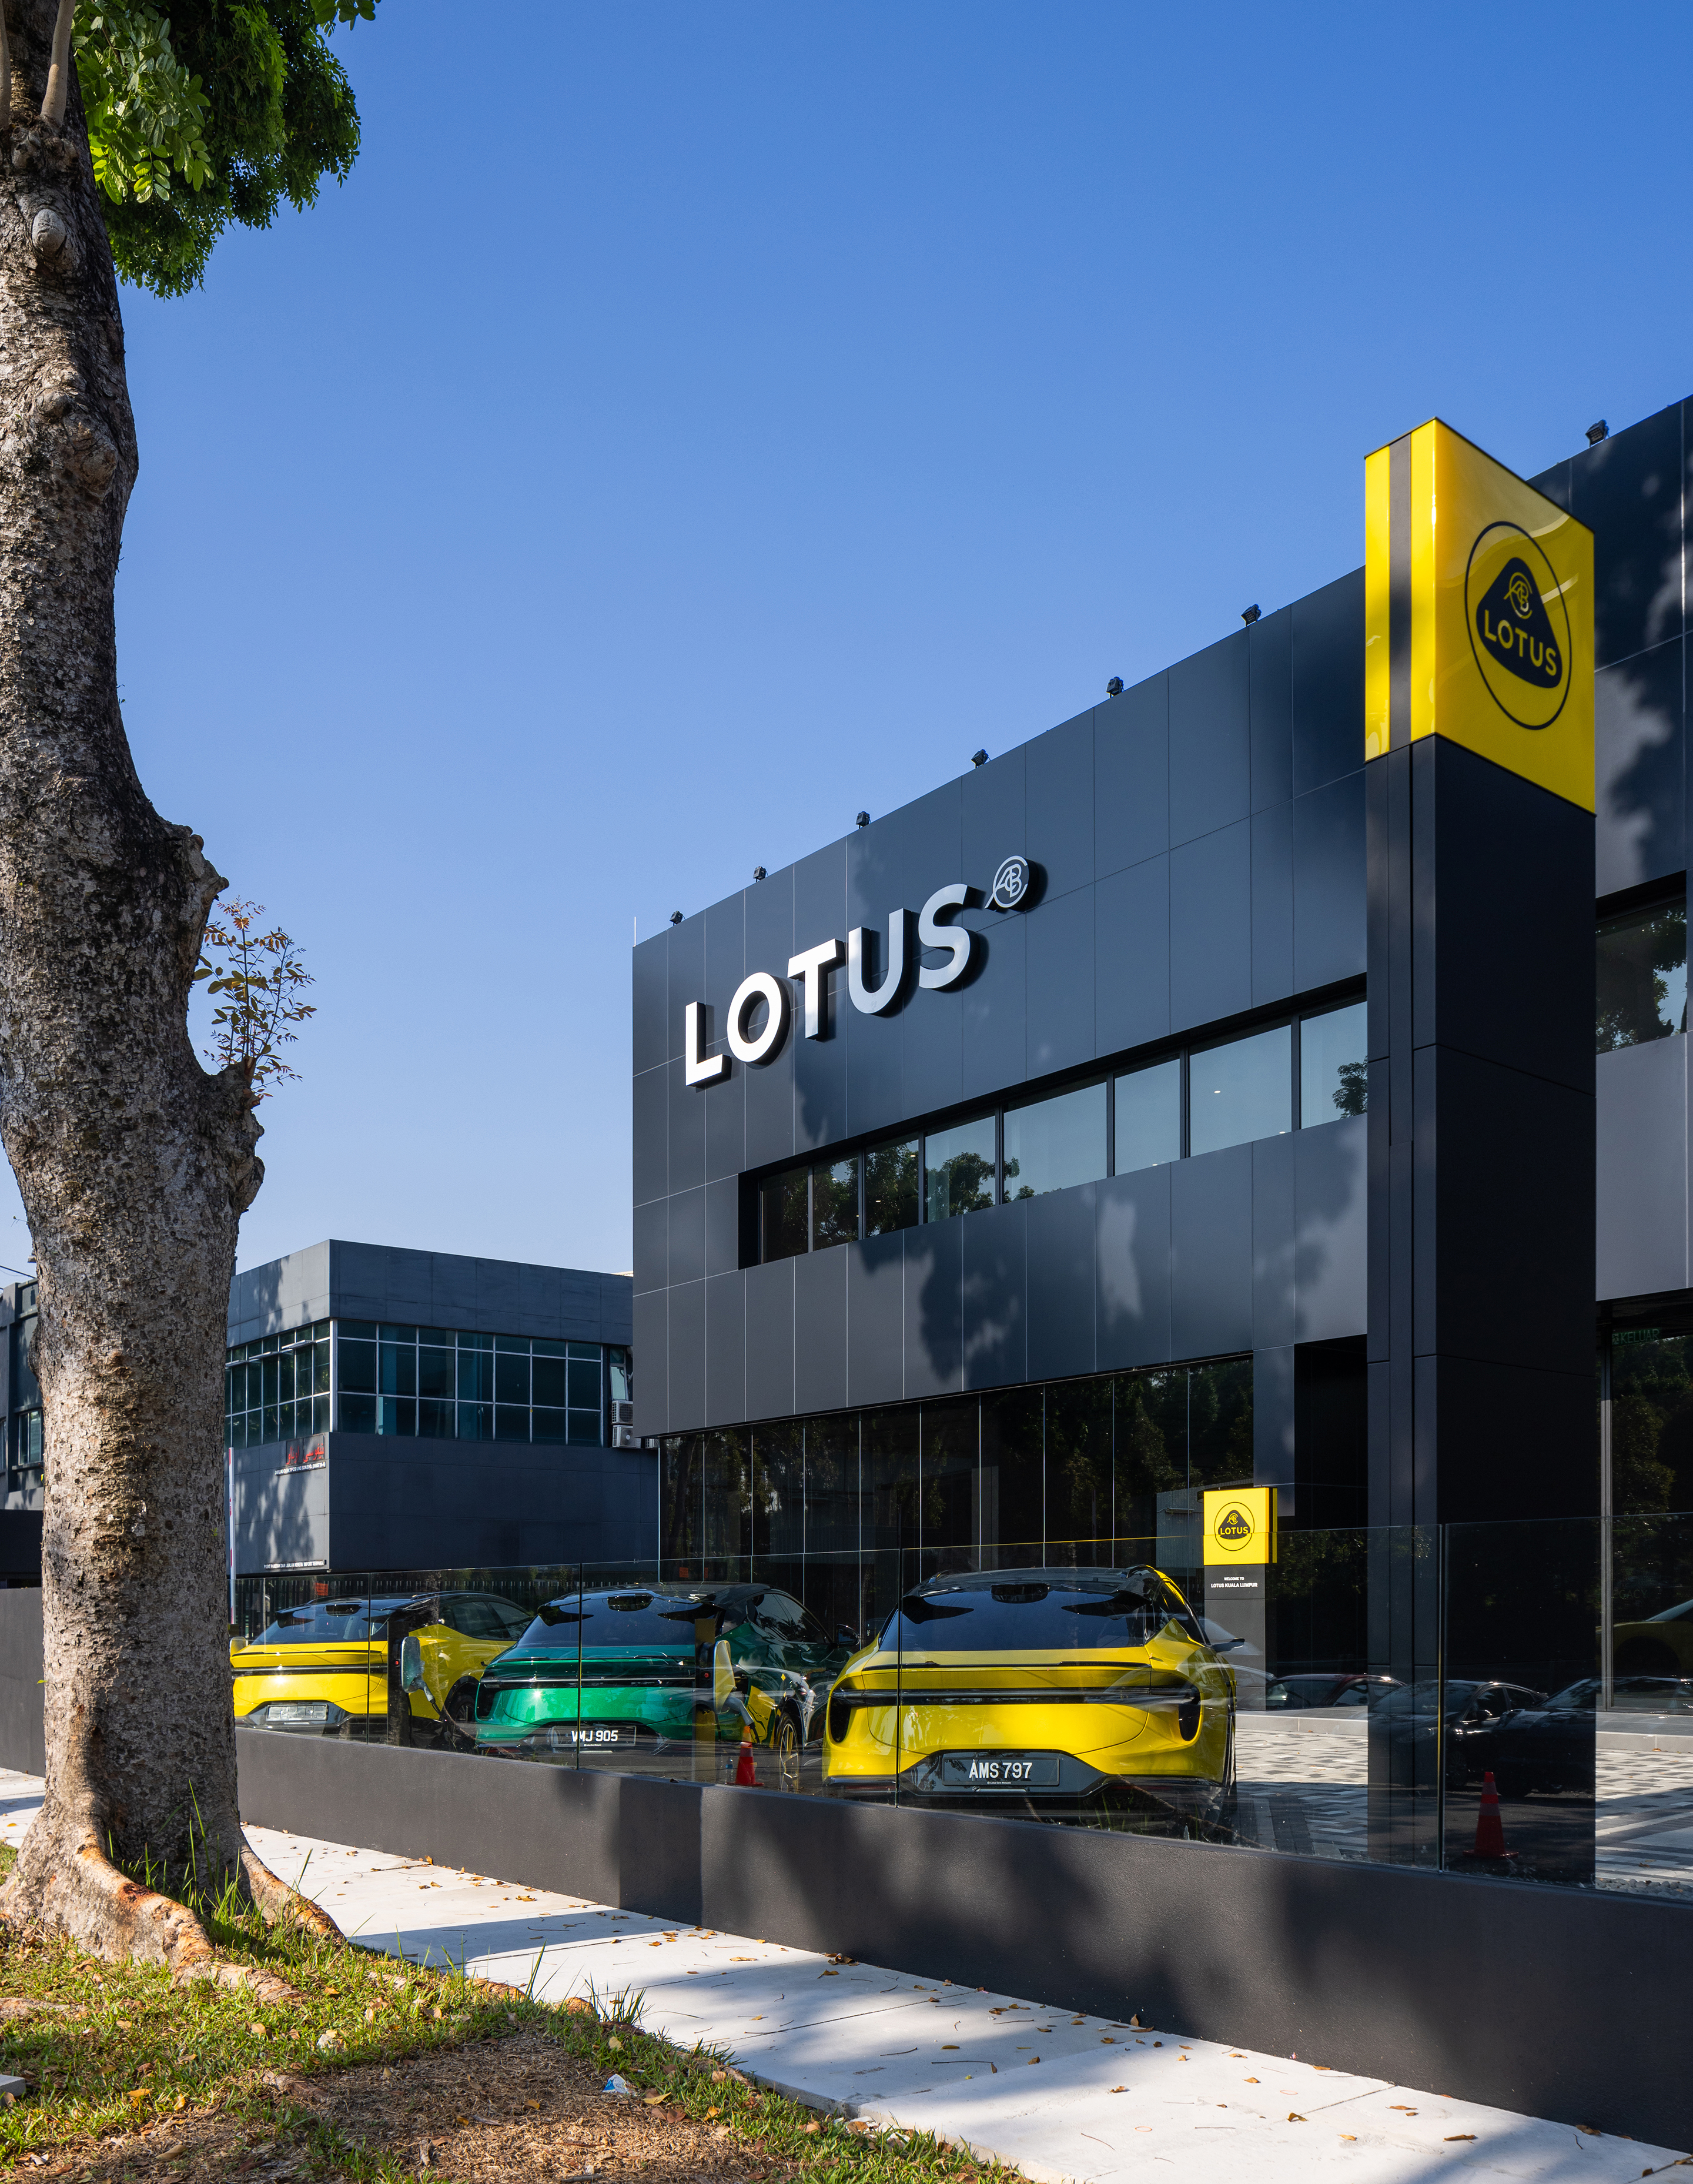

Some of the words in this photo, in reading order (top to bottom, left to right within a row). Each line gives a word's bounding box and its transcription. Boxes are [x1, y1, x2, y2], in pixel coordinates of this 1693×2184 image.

[1484, 609, 1557, 676] LOTUS
[685, 884, 973, 1086] LOTUS
[1621, 1329, 1660, 1344] KELUAR
[1220, 1526, 1249, 1535] LOTUS
[1612, 1588, 1648, 1600] EGACY
[571, 1730, 593, 1742] VMJ
[595, 1730, 618, 1741] 905
[969, 1762, 999, 1778] AMS
[1002, 1762, 1032, 1778] 797
